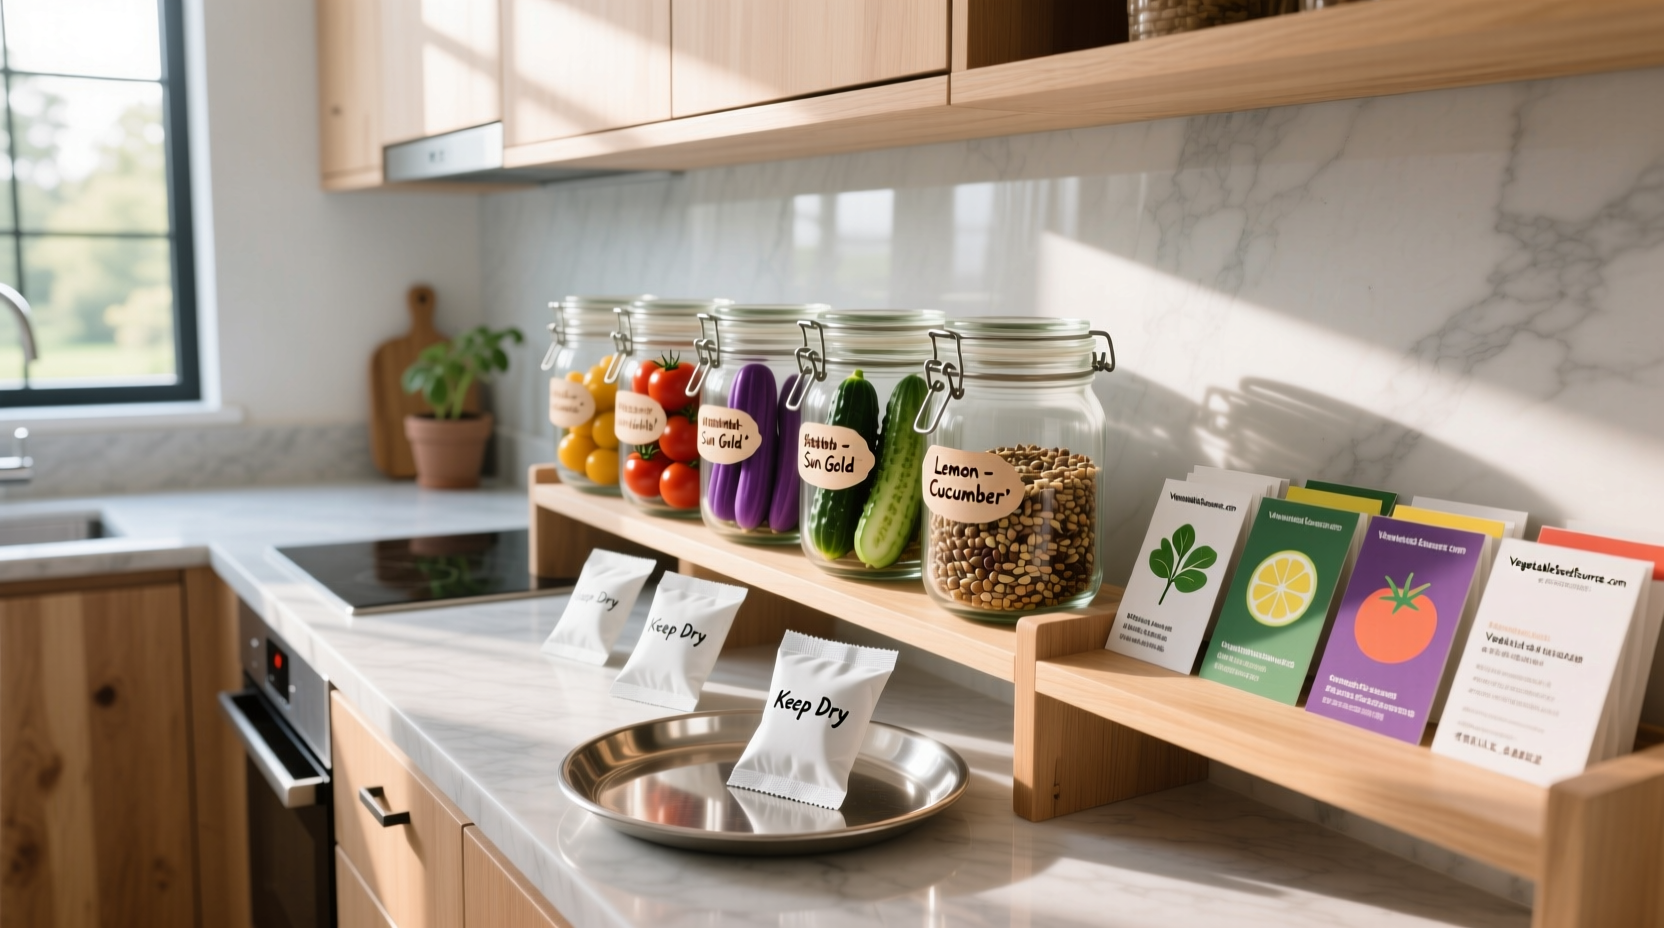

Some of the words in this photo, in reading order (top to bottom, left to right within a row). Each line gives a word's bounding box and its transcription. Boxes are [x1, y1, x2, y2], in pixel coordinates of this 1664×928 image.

[804, 451, 822, 470] Sun
[824, 455, 855, 473] Gold
[934, 456, 979, 479] Lemon
[596, 591, 619, 612] Dry
[648, 617, 677, 641] Keep
[679, 623, 706, 648] Dry
[773, 689, 812, 721] Keep
[814, 696, 850, 729] Dry
